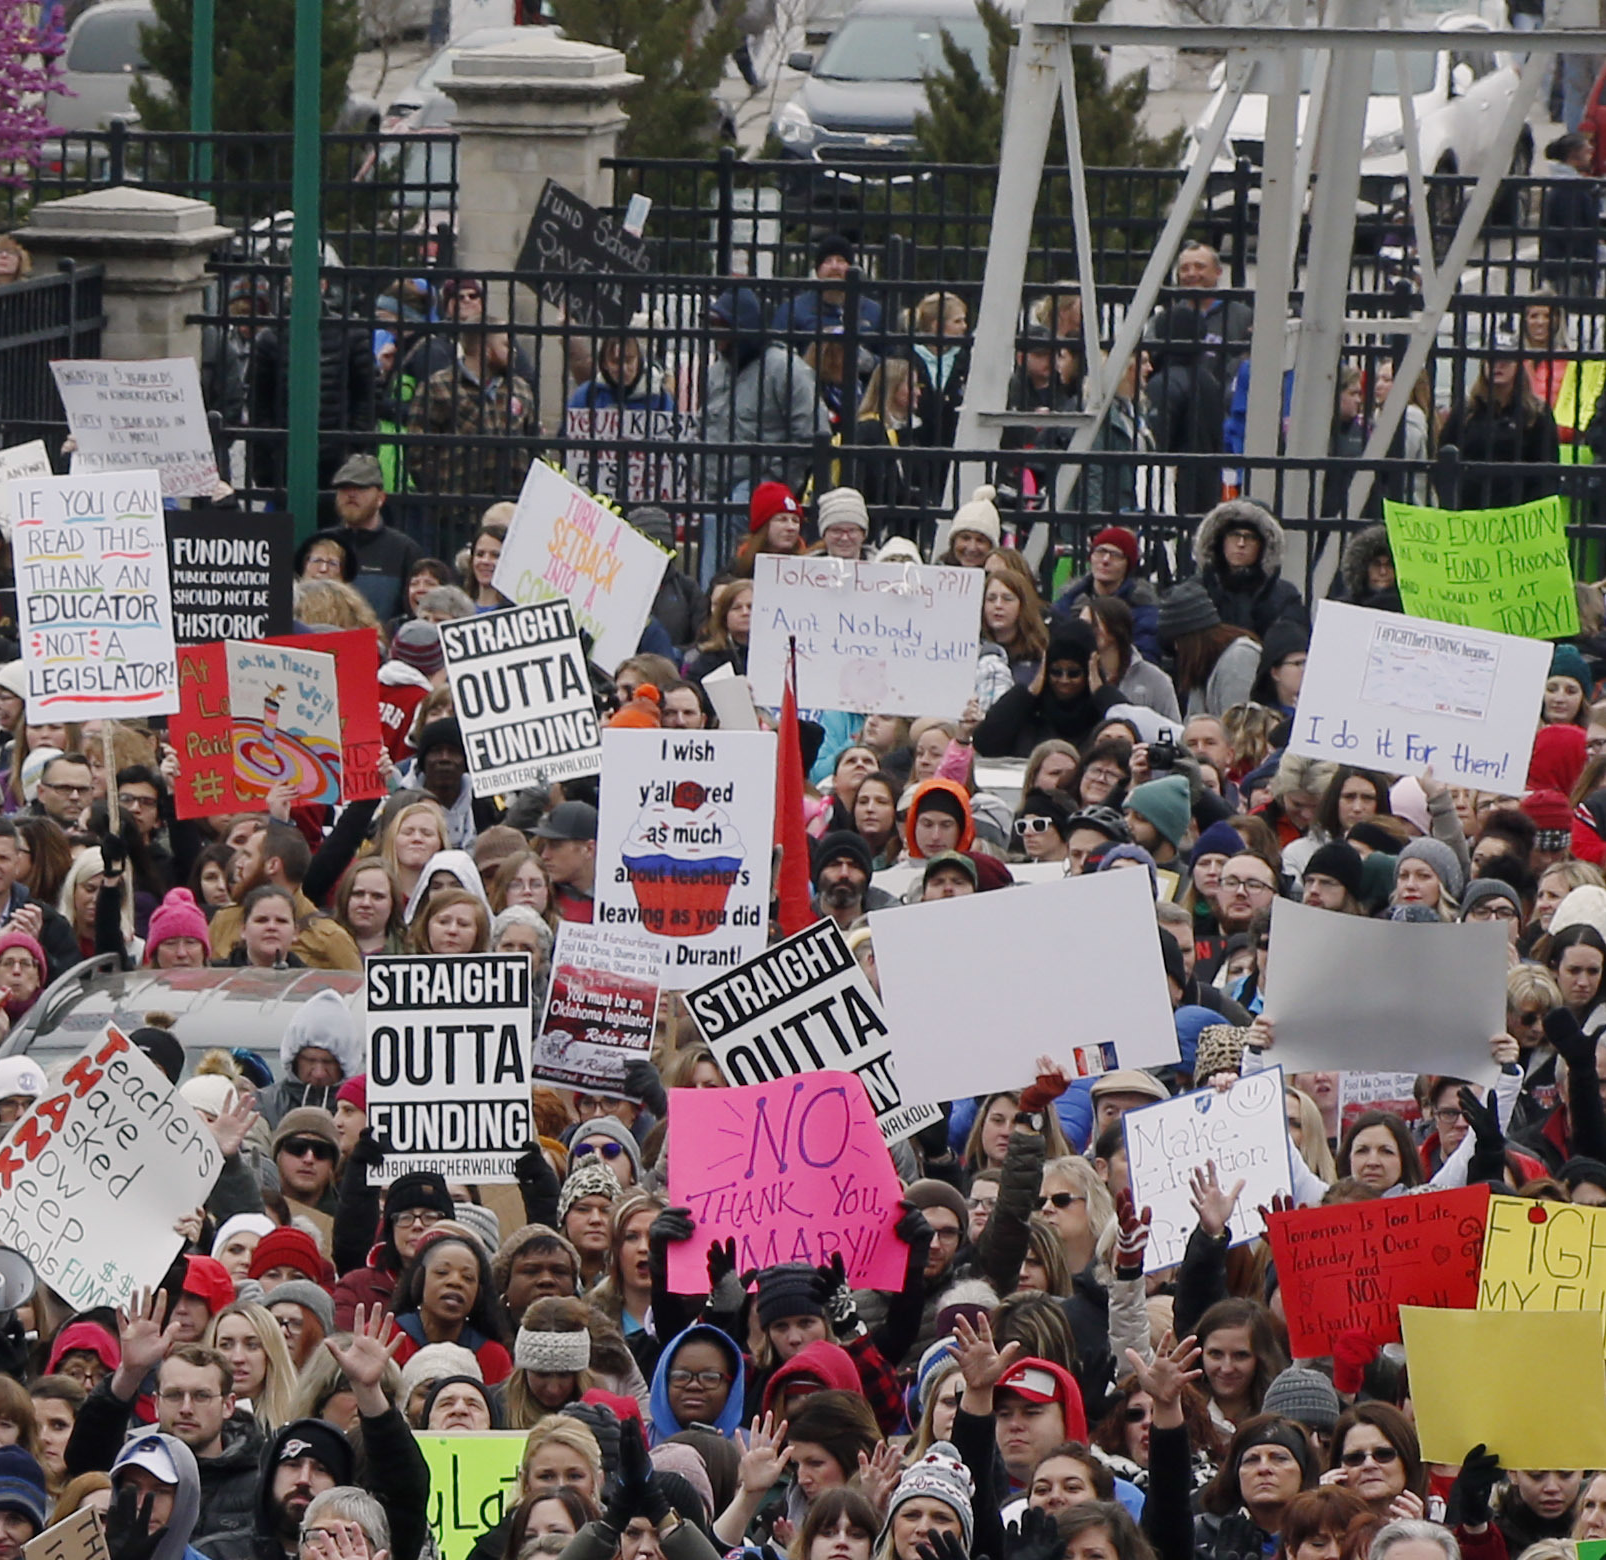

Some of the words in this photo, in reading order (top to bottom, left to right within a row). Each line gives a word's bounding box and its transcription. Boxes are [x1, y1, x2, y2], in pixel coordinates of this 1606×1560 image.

[18, 491, 43, 519] IF
[59, 490, 104, 516] YOU
[113, 490, 158, 514] CAN
[28, 529, 85, 555] READ
[173, 537, 270, 567] FUNDING
[23, 563, 105, 590] THANK
[115, 564, 151, 589] AN
[173, 570, 209, 584] PUBLIC
[210, 571, 270, 586] EDUCATION
[27, 594, 161, 625] EDUCATOR
[173, 589, 222, 606] SHOULD
[224, 590, 250, 606] NOT
[252, 590, 269, 607] BE
[45, 631, 88, 657] NOT
[105, 631, 126, 656] A
[443, 603, 572, 660] STRAIGHT
[29, 661, 174, 697] LEGISLATOR!
[457, 653, 586, 719] OUTTA
[466, 710, 599, 771] FUNDING
[1305, 716, 1324, 744] I
[1331, 720, 1359, 749] do
[1376, 728, 1395, 758] it
[1405, 734, 1438, 764] For
[1451, 742, 1510, 780] them!
[370, 961, 527, 1006] STRAIGHT
[371, 1024, 525, 1087] OUTTA
[370, 1102, 528, 1151] FUNDING
